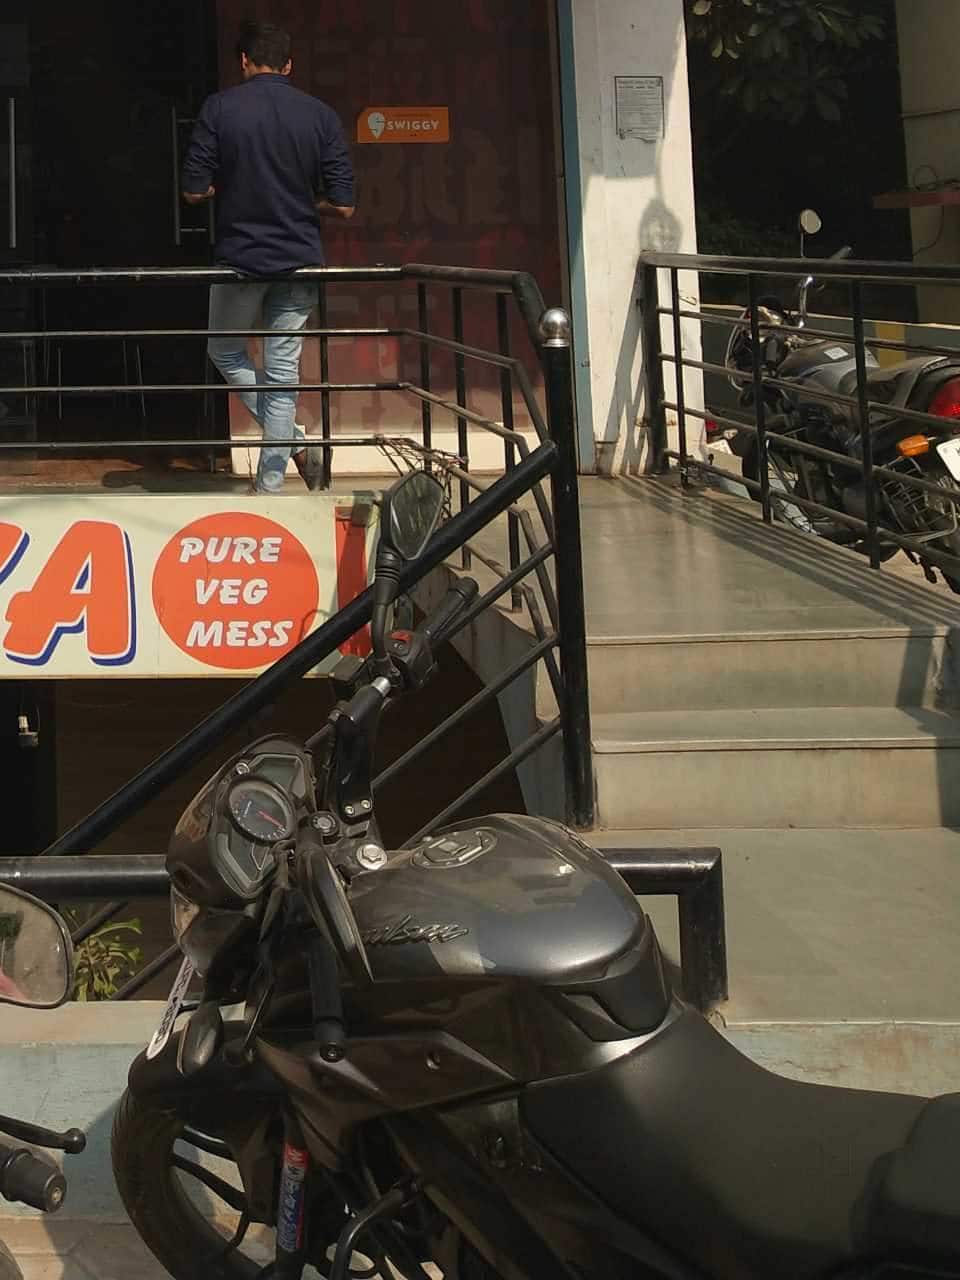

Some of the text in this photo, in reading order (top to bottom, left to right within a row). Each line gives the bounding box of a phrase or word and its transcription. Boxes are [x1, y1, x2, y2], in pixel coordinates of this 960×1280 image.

[387, 120, 439, 130] SWIGGY
[179, 536, 282, 565] PURE
[195, 578, 268, 605] VEG
[186, 620, 293, 647] MESS
